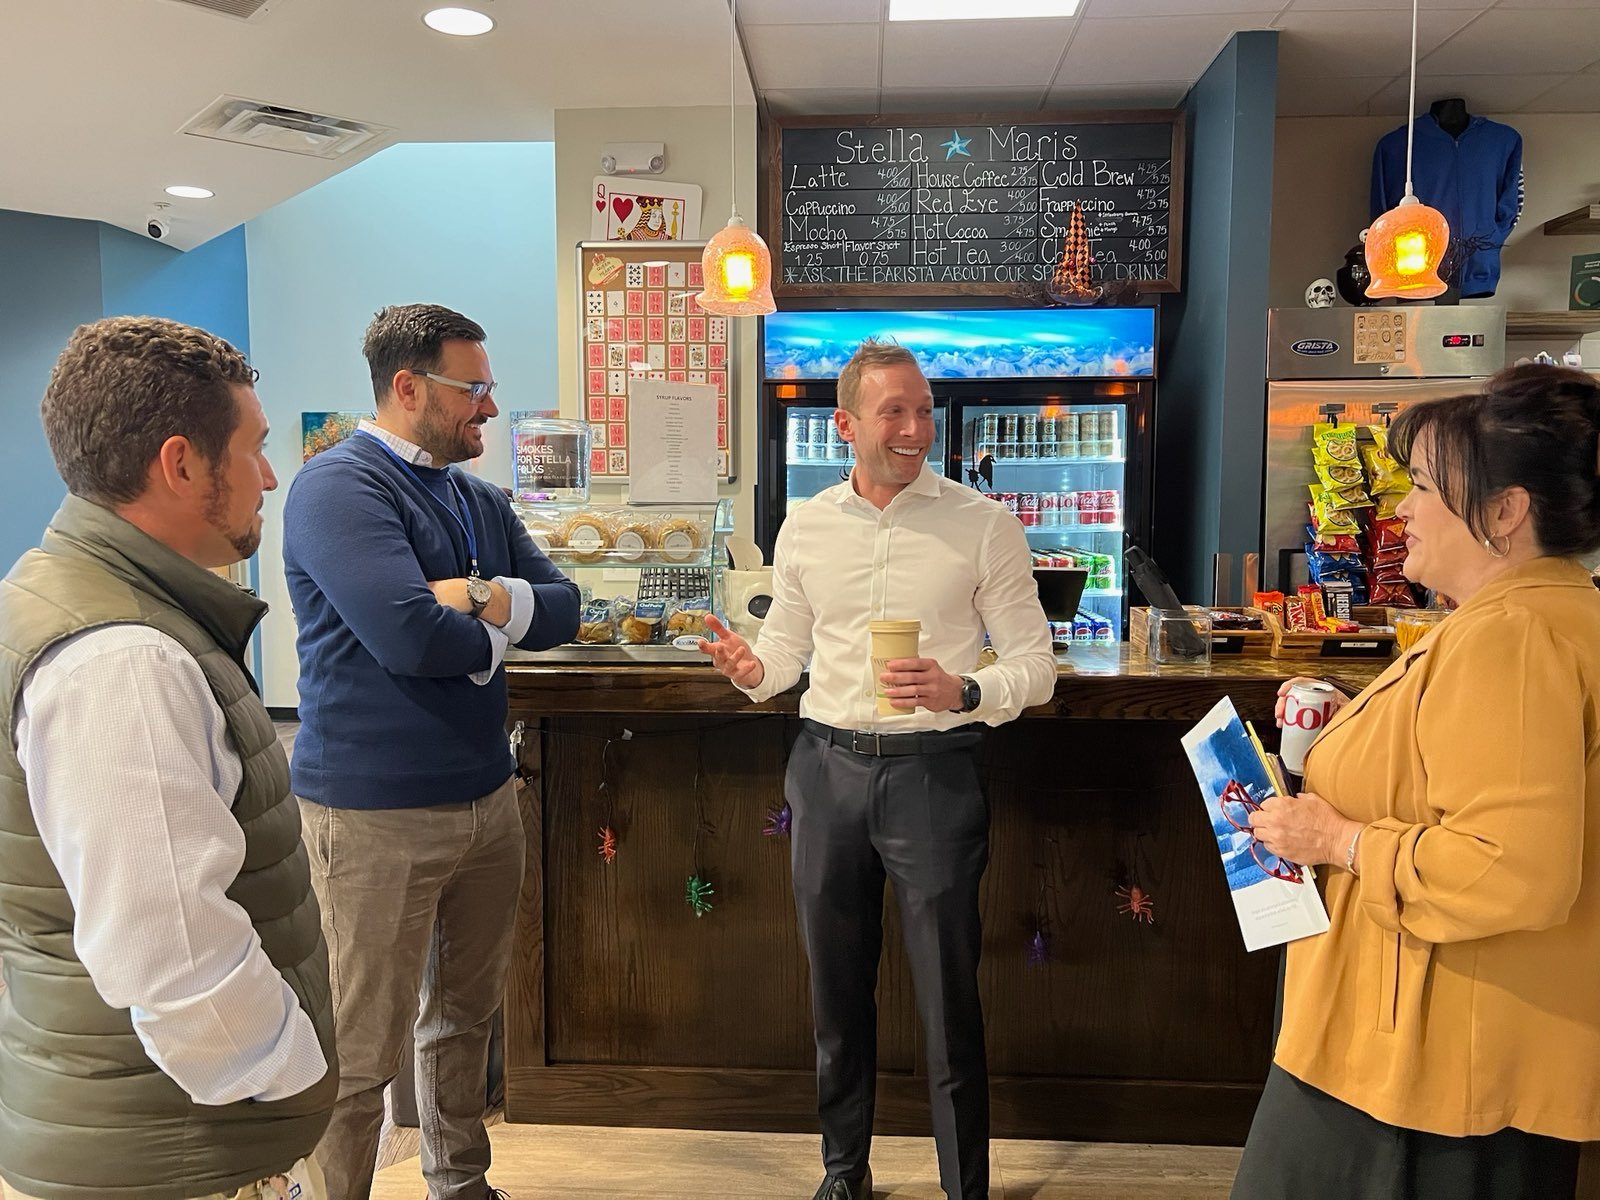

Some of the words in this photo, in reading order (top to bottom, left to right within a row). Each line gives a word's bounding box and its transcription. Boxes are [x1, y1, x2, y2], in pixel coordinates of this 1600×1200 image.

[836, 127, 929, 164] Stella
[986, 126, 1078, 162] Maris
[789, 164, 849, 190] Latte
[916, 162, 960, 188] House
[963, 162, 1010, 188] Coffee
[1042, 160, 1084, 187] Cold
[1092, 160, 1135, 186] Brew
[596, 183, 606, 200] Q
[916, 188, 954, 214] Red
[960, 187, 999, 214] Eye
[1039, 186, 1115, 213] Frappccino
[788, 215, 848, 241] Mocha
[912, 214, 944, 240] Hot
[945, 214, 989, 240] Cocoa
[784, 241, 819, 252] Espresso
[820, 241, 842, 250] Shot
[845, 240, 876, 252] Flavor
[876, 240, 900, 250] Shot
[912, 240, 947, 266] Hot
[950, 240, 991, 265] Tea
[1041, 238, 1064, 264] Ch
[794, 252, 824, 267] 1.25
[859, 251, 890, 266] 0.75
[834, 266, 869, 283] THE
[872, 265, 936, 283] BARISTA
[940, 264, 992, 282] ABOUT
[994, 264, 1029, 283] OUR
[1115, 263, 1167, 280] DRINK
[1297, 342, 1334, 350] GRISTA
[516, 445, 554, 454] SMOKES
[516, 455, 533, 464] FOR
[533, 455, 572, 464] STELLA
[517, 464, 544, 474] FOLKS
